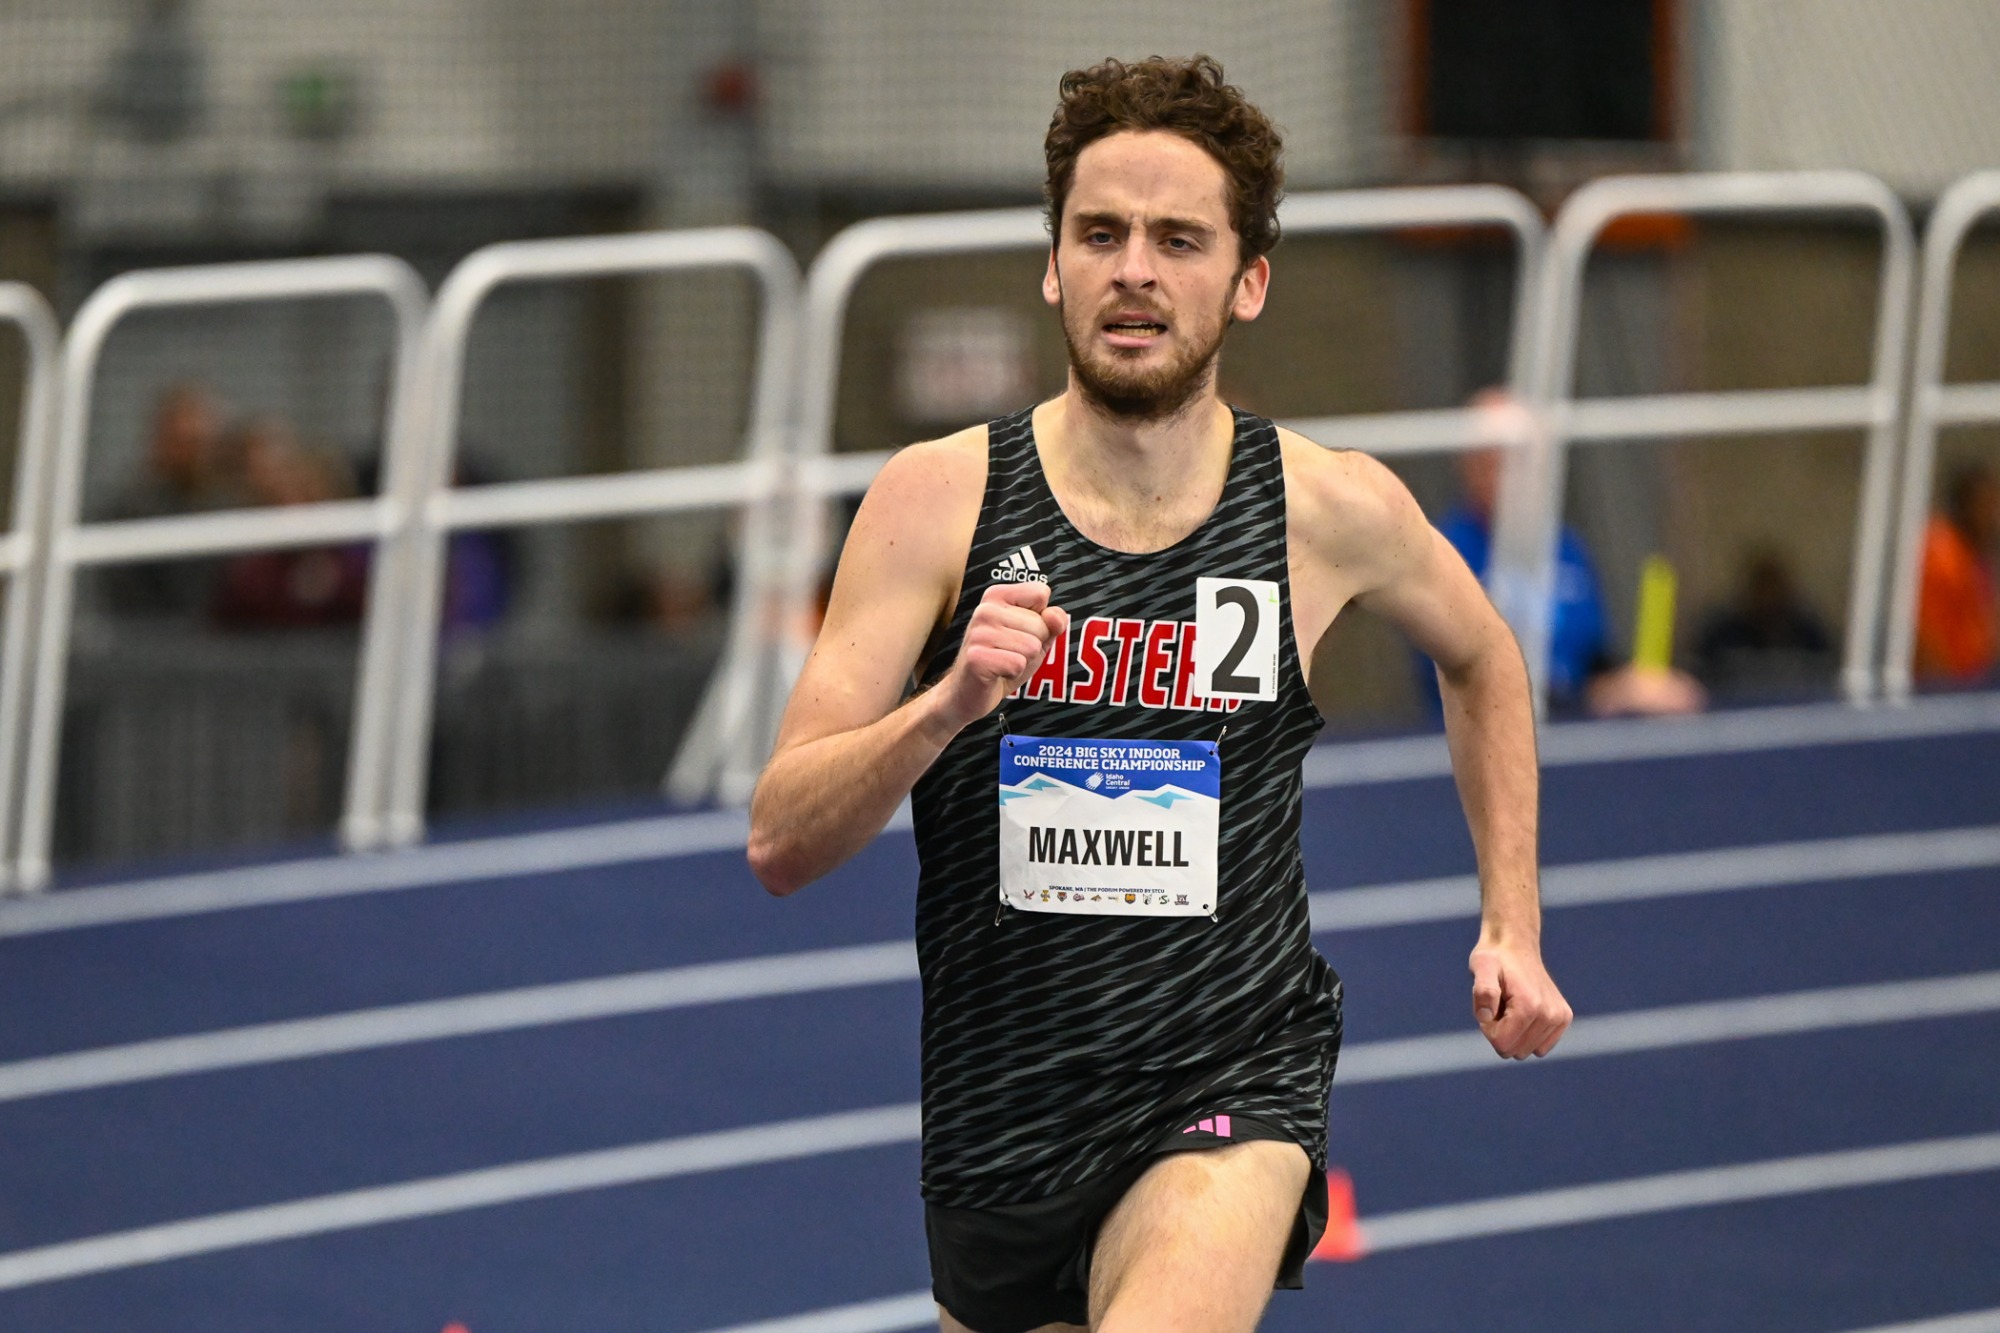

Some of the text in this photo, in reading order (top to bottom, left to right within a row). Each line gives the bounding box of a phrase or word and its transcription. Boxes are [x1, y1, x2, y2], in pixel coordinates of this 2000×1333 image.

[991, 567, 1048, 584] adidas
[1211, 585, 1260, 694] 2
[1005, 613, 1243, 713] ASTER
[1014, 755, 1206, 771] CONFERENCE CHAMPIONSHIP
[1039, 745, 1181, 759] 2024 BIG SKY INDOOR
[1029, 826, 1189, 867] MAXWELL
